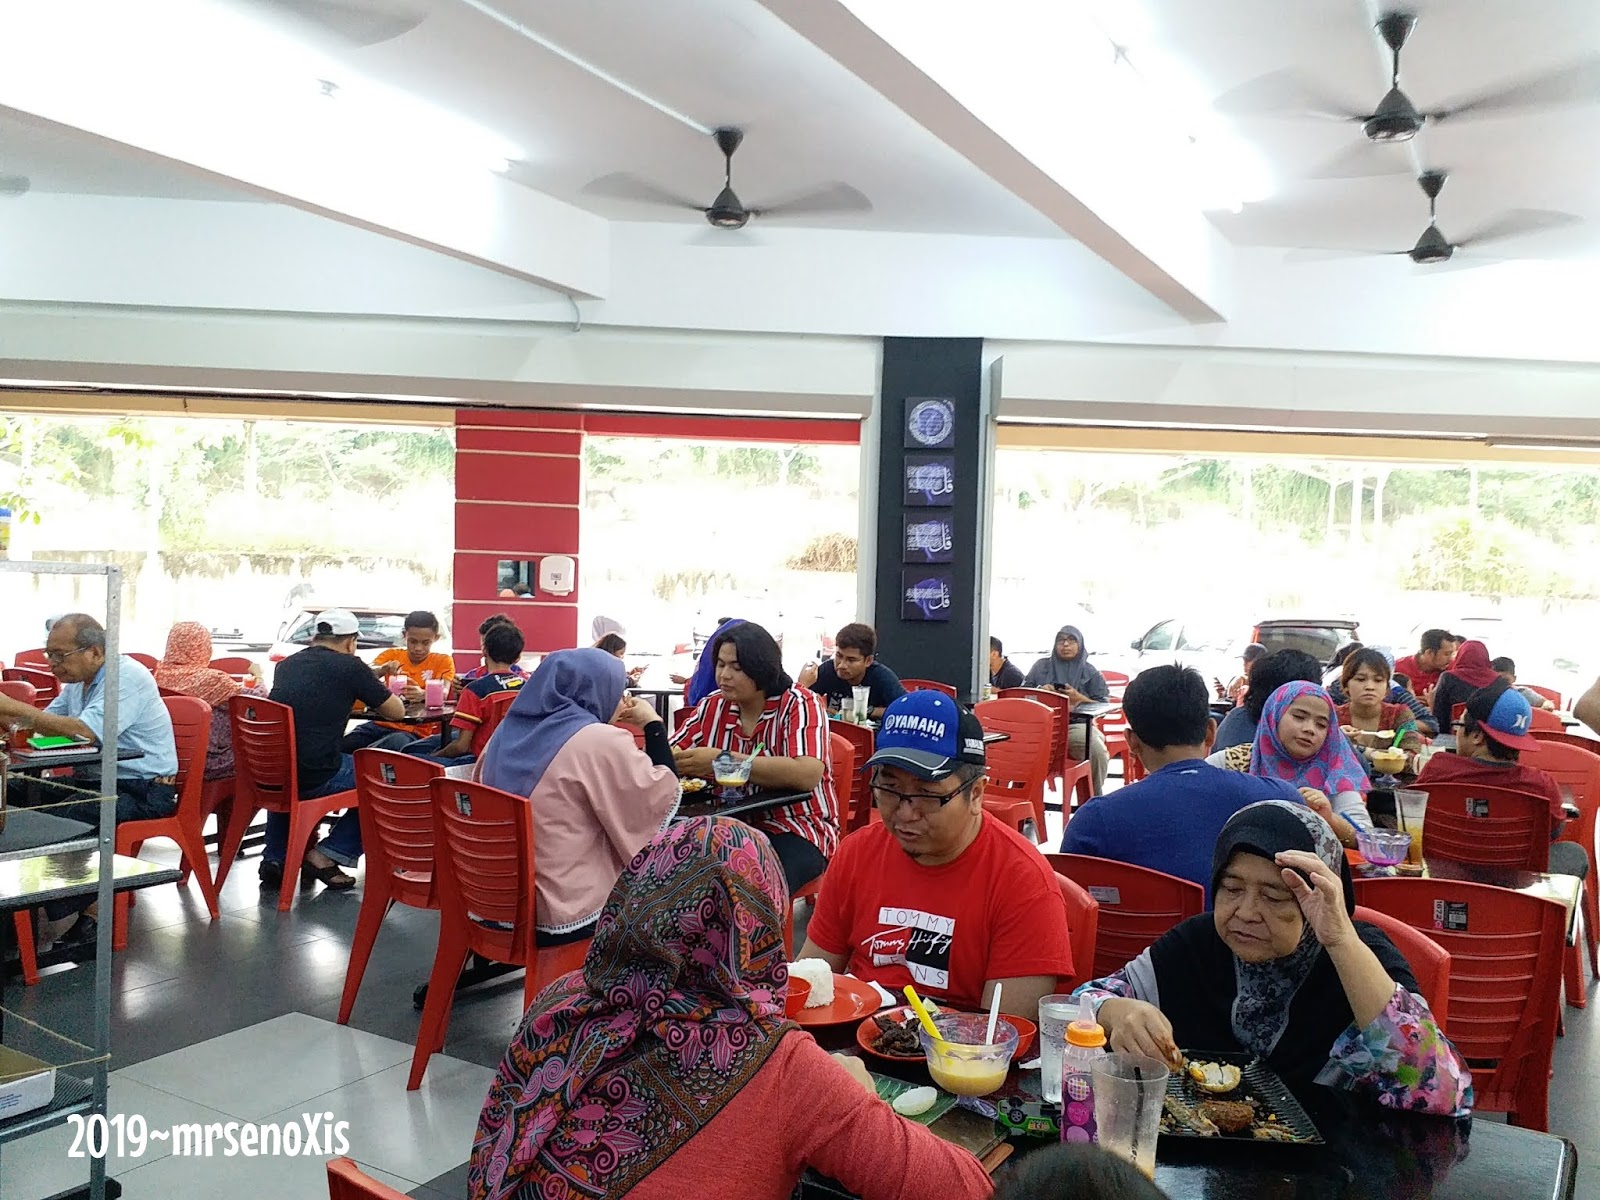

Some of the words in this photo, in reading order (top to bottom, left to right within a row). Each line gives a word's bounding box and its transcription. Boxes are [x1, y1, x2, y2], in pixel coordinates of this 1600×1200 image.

[886, 730, 939, 742] RACING
[894, 715, 946, 738] YAMAHA
[883, 908, 954, 934] TOMMY
